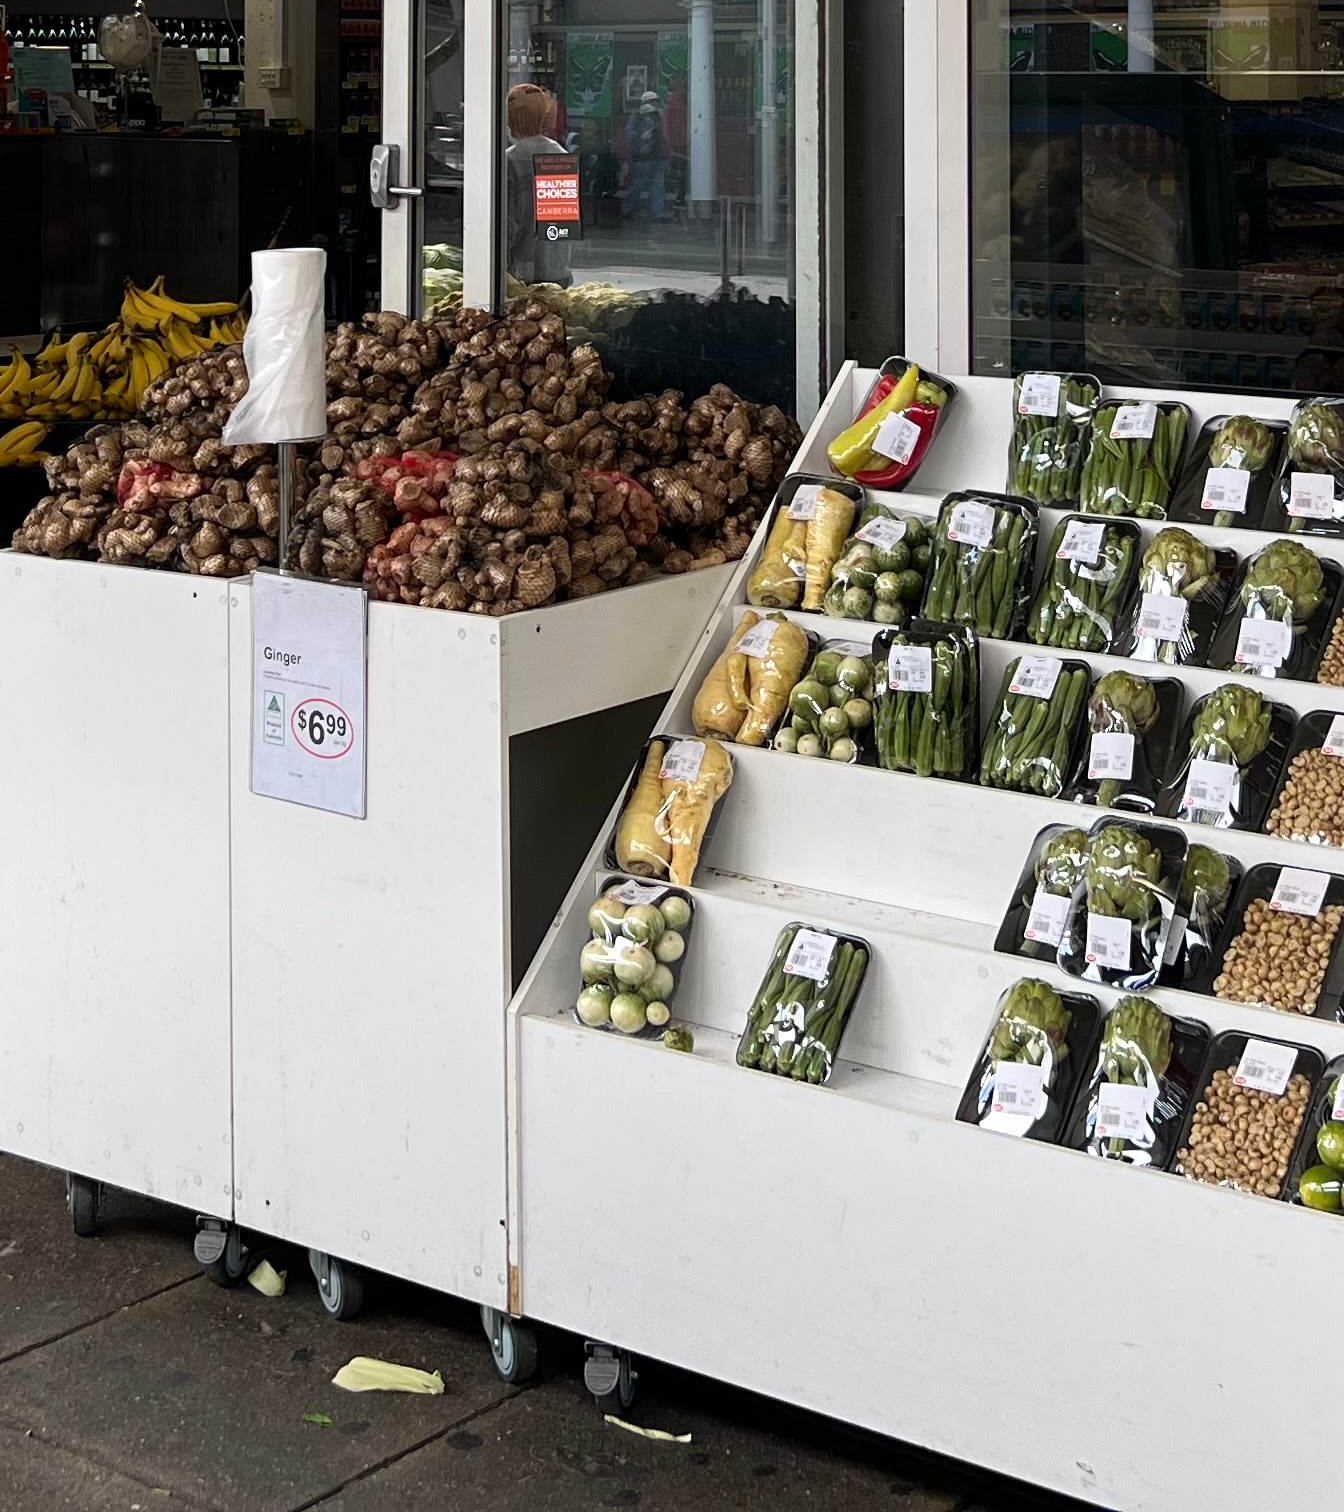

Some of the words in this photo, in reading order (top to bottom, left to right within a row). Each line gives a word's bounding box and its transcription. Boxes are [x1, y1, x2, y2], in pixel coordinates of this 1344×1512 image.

[536, 179, 577, 188] HEALTHIER
[537, 189, 577, 199] CHOICES
[537, 207, 577, 215] CANBERRA
[263, 646, 302, 667] Ginger
